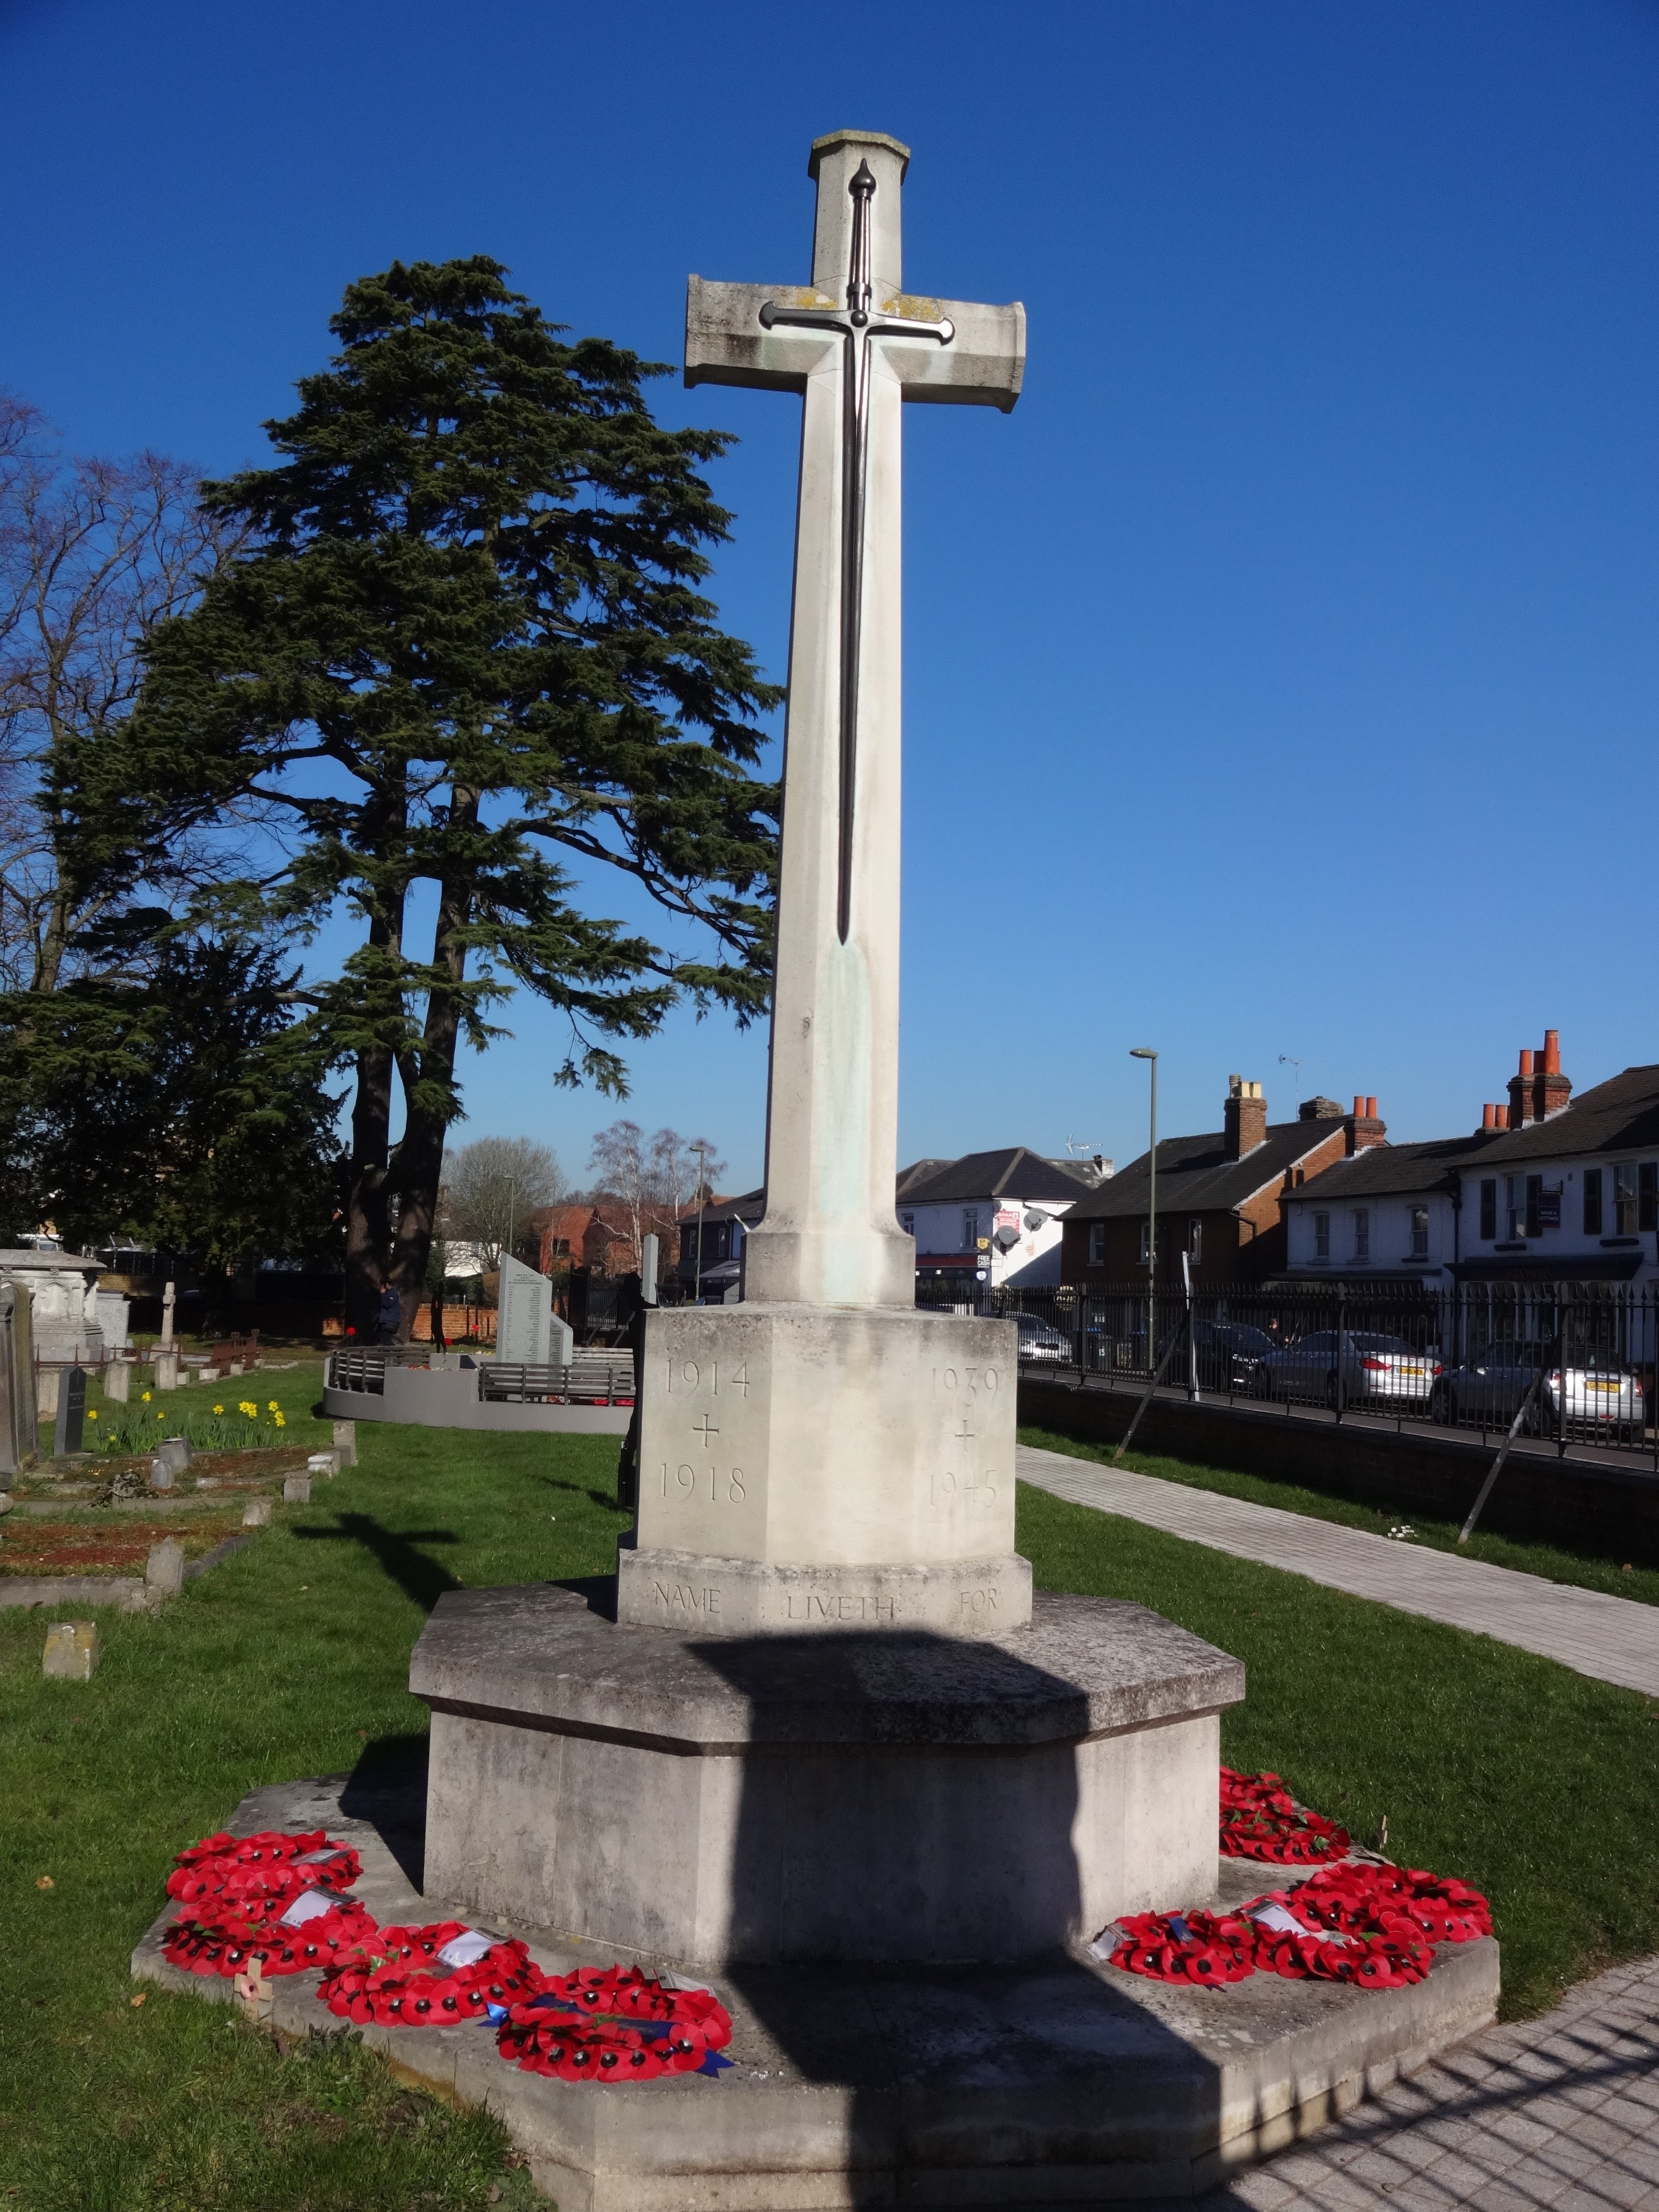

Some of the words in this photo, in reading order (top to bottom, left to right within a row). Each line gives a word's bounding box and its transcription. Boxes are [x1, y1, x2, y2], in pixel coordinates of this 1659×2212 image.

[666, 1359, 750, 1399] 1914
[932, 1368, 998, 1407] 1939
[661, 1462, 745, 1504] 1918
[930, 1469, 997, 1509] 1945
[653, 1581, 721, 1614] NAME
[788, 1596, 895, 1620] LIVETH
[961, 1588, 998, 1613] FOR
